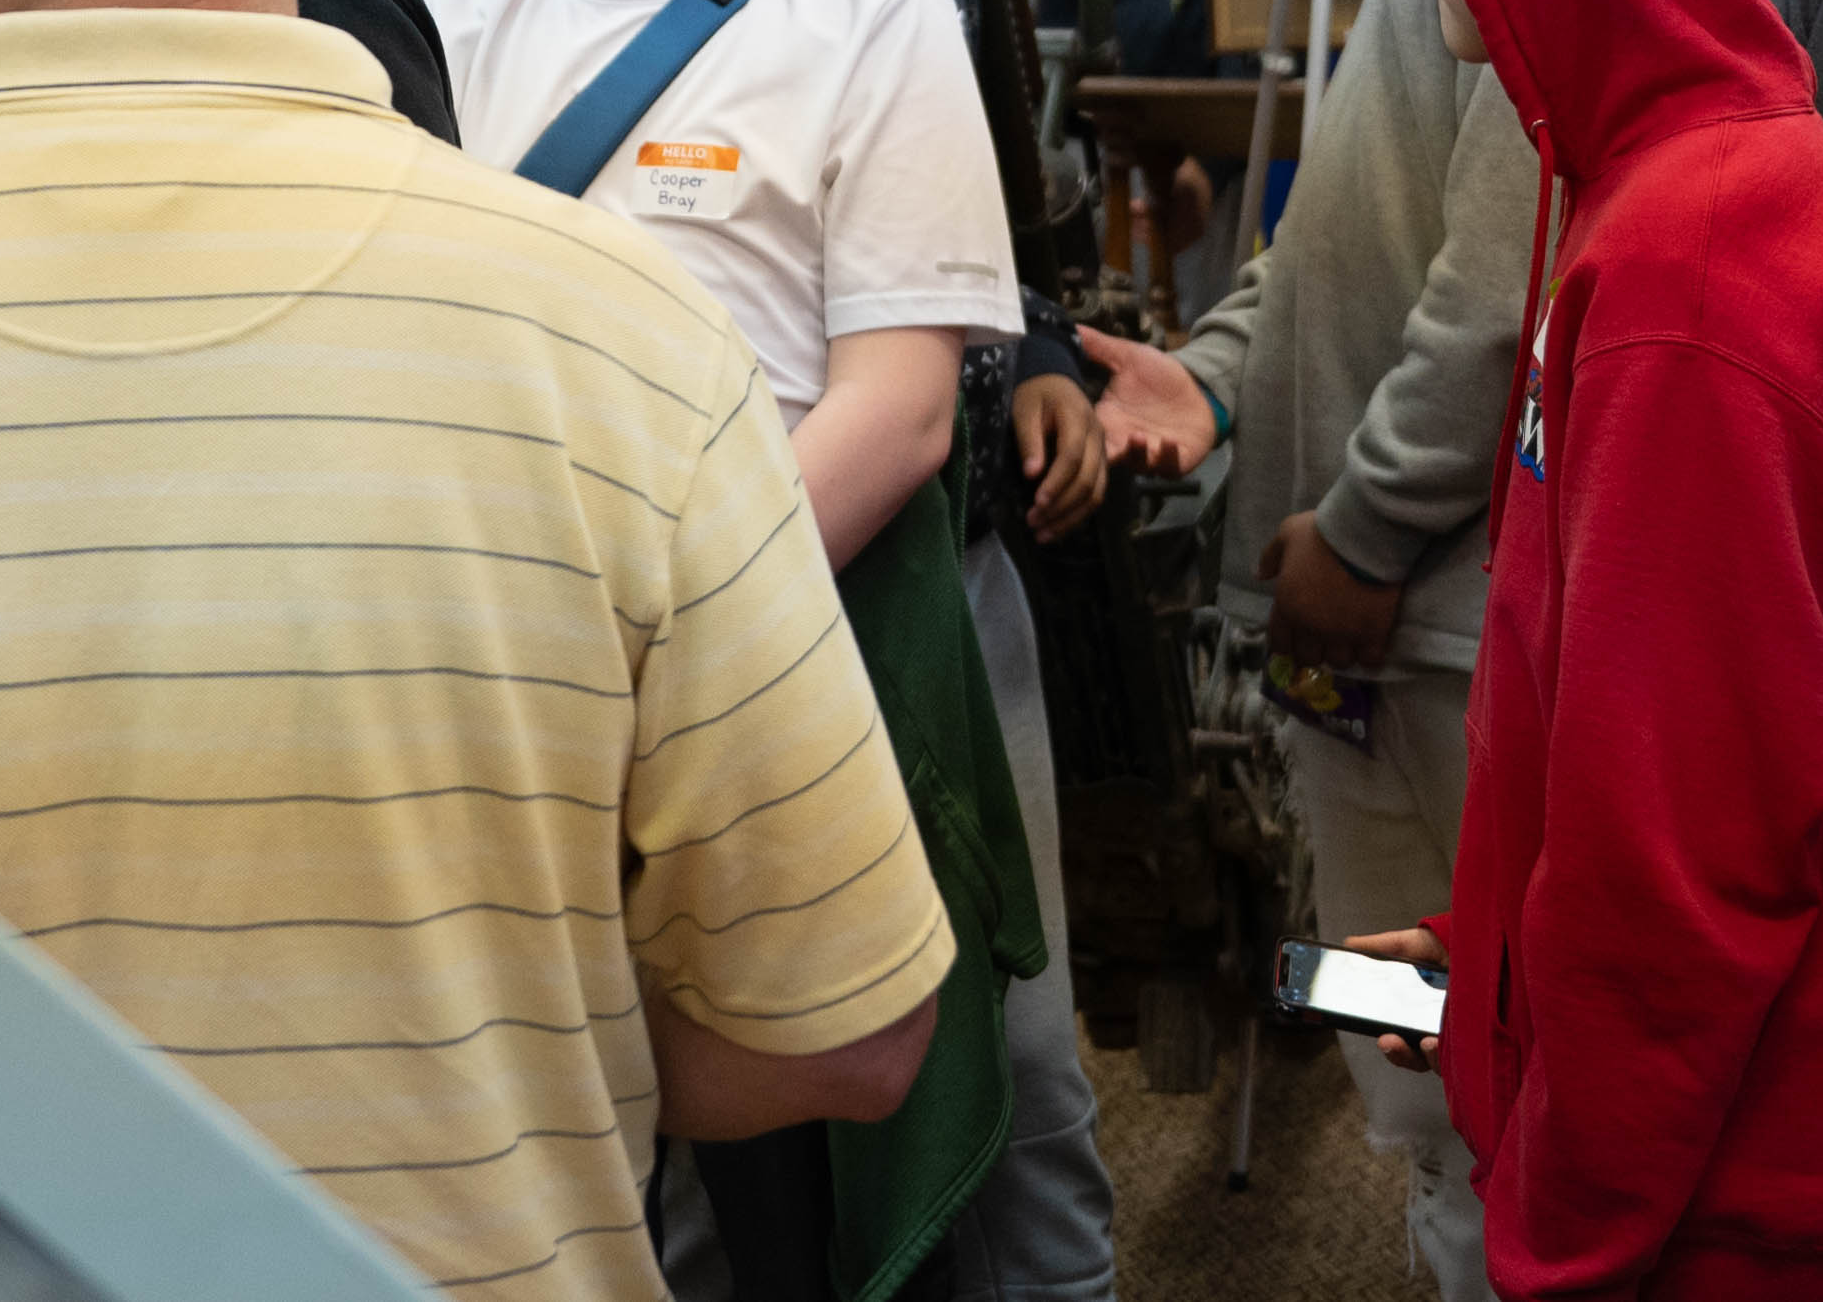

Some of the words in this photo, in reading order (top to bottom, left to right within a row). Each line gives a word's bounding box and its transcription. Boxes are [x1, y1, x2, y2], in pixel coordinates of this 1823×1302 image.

[662, 147, 706, 159] HELLO
[649, 168, 707, 190] Cooper
[657, 189, 697, 213] Bray
